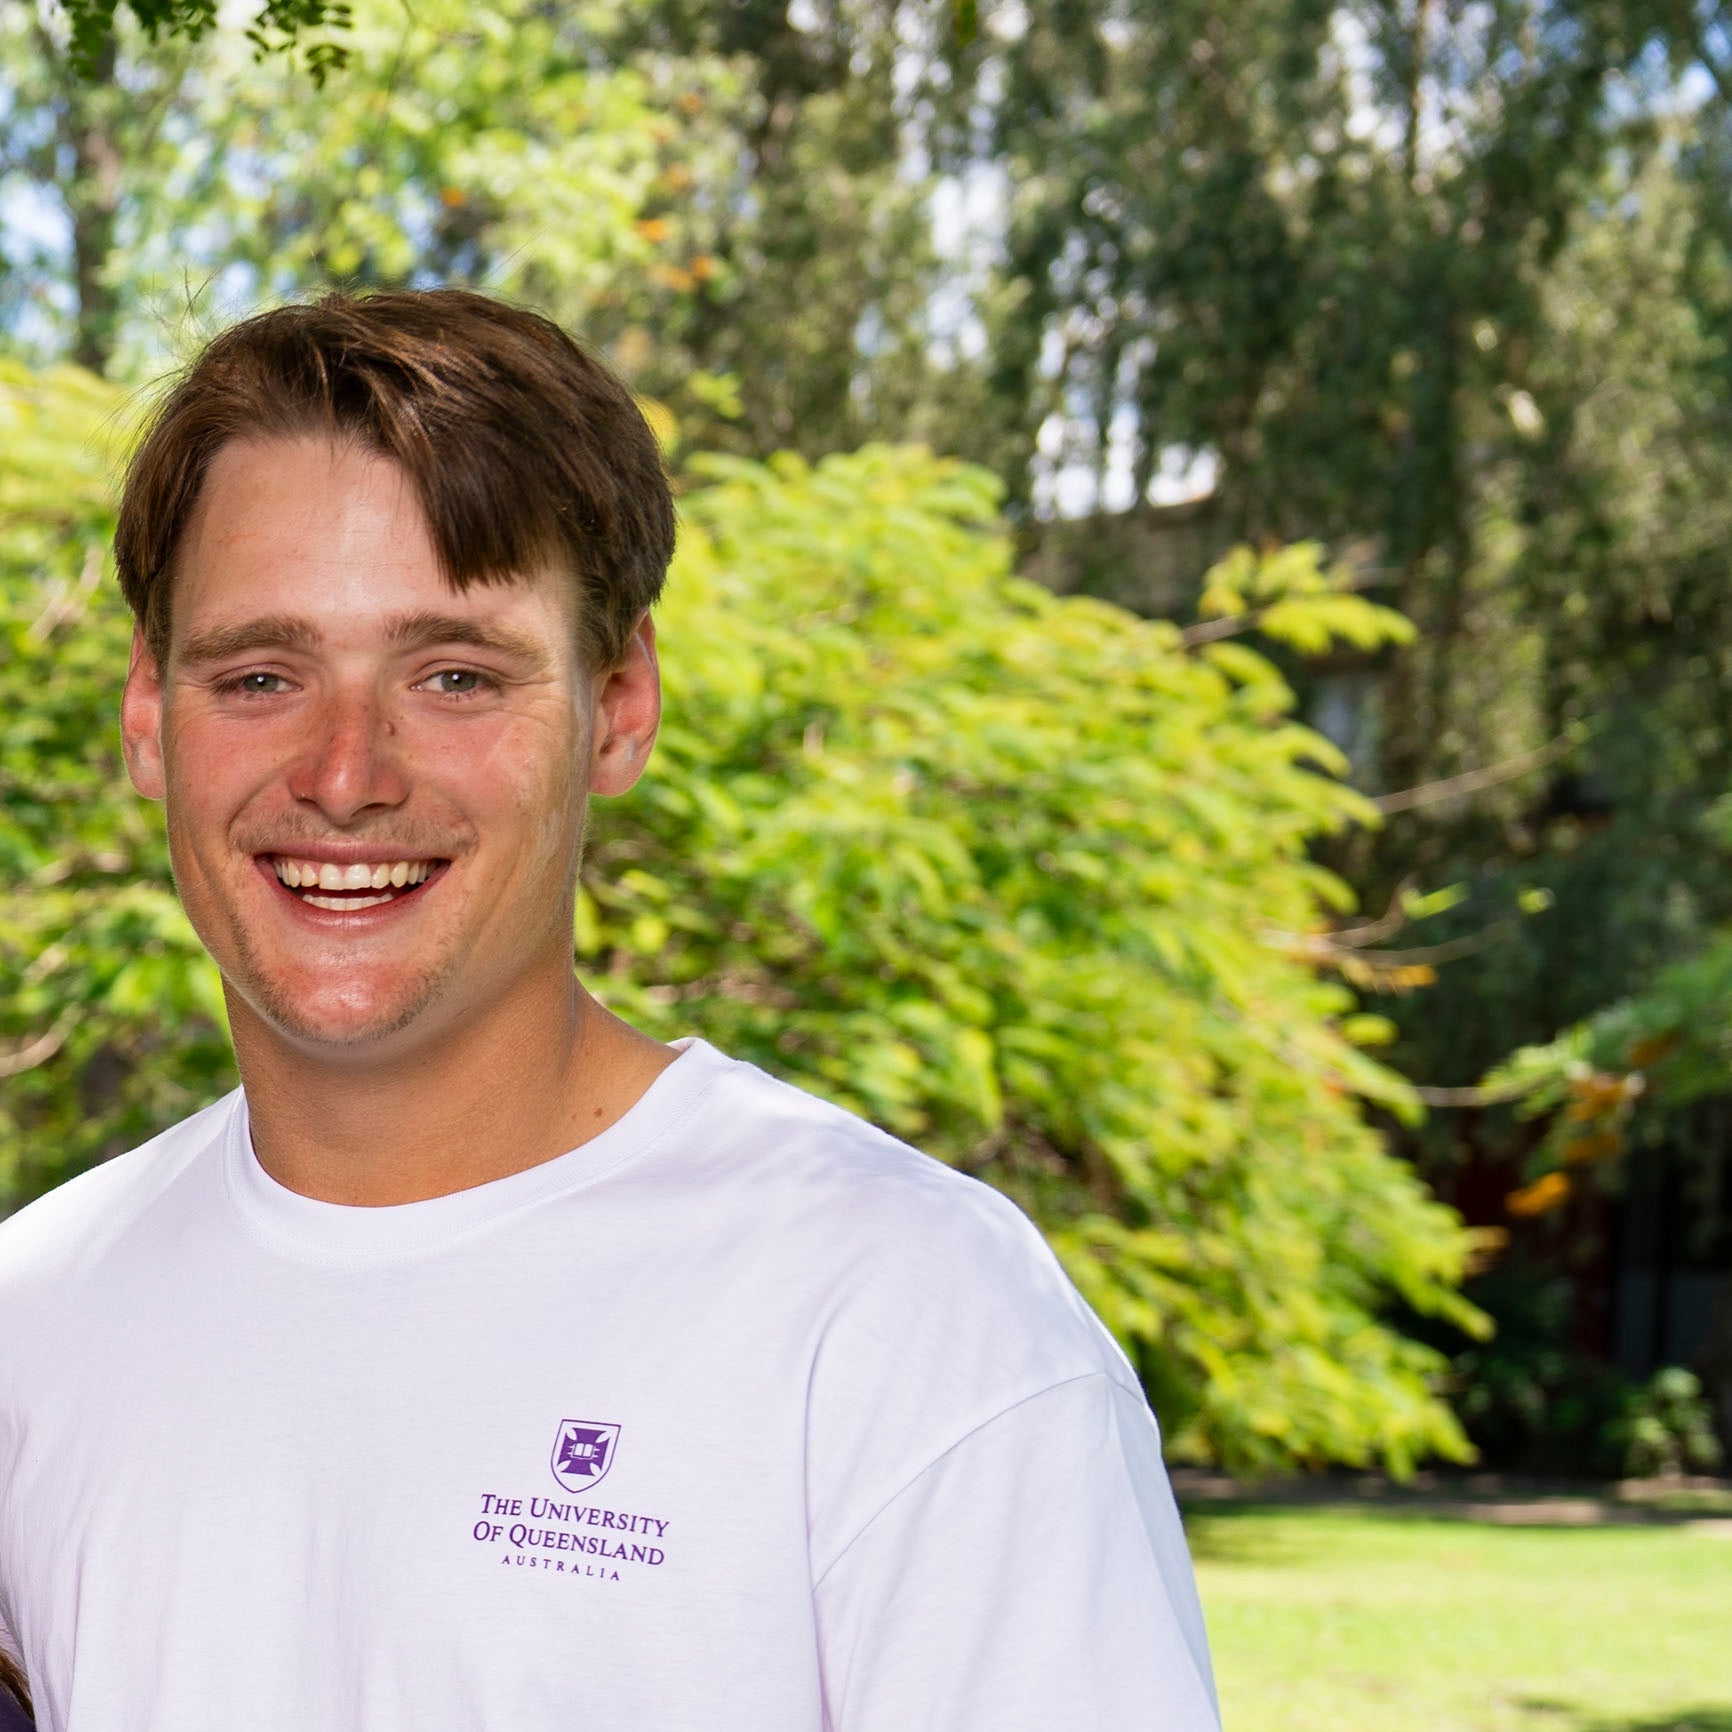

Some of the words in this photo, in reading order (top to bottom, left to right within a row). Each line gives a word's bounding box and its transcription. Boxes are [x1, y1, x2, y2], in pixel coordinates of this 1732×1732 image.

[480, 1493, 522, 1517] THE
[530, 1497, 670, 1538] UNIVERSITY
[473, 1520, 504, 1542] OF
[508, 1523, 665, 1566] QUEENSLAND
[502, 1555, 620, 1581] AUSTRALIA
